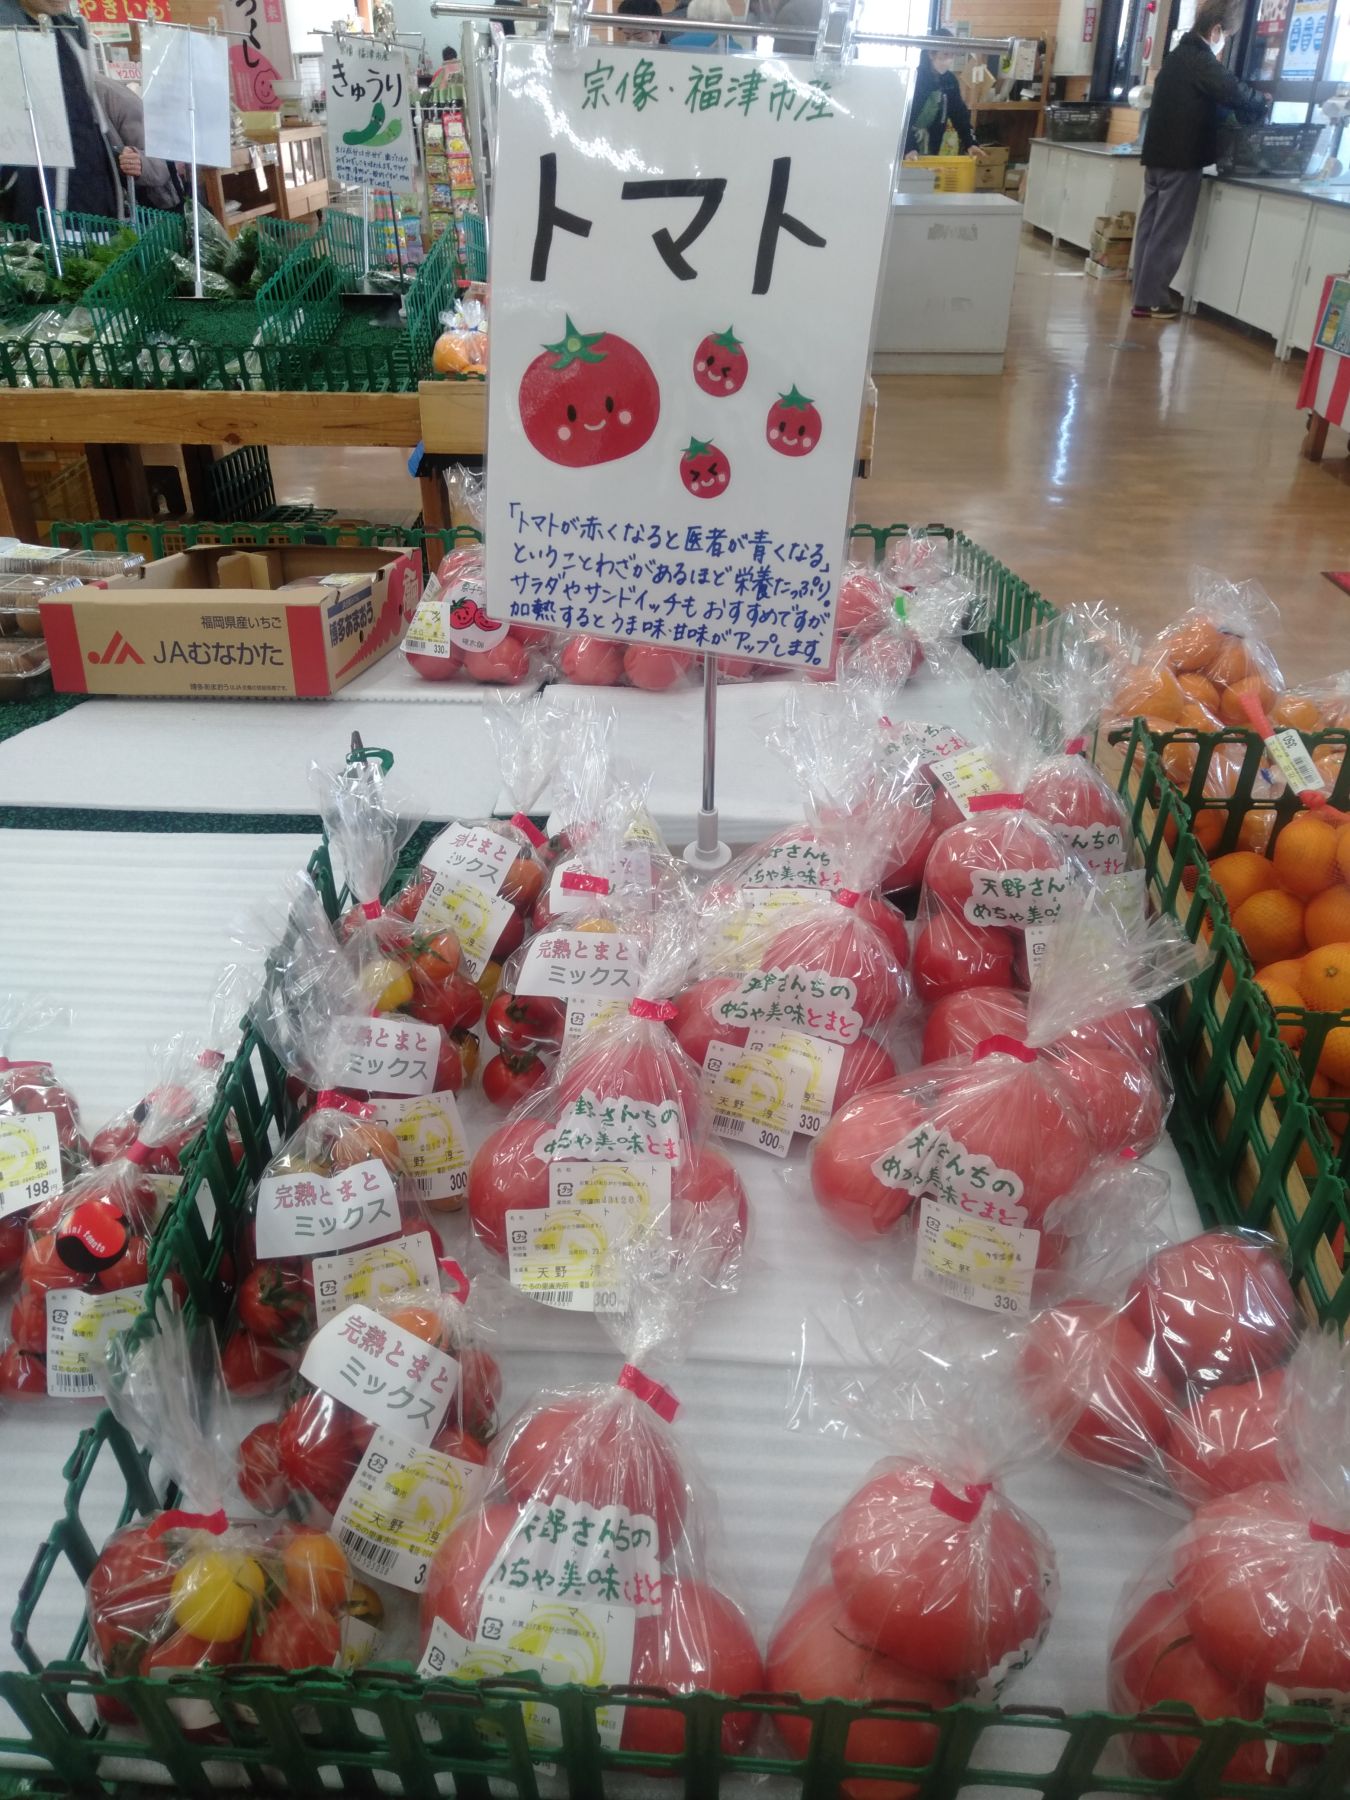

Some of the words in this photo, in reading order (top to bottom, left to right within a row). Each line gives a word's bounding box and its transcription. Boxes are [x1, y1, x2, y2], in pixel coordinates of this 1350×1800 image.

[332, 59, 402, 107] きゅうり
[582, 58, 834, 121] 宗像・福津市産
[530, 152, 828, 295] トマト
[509, 502, 830, 573] 「トマトが赤くなると医者が青くなる」
[510, 571, 831, 637] サラダやサンドイッチもおすすめですが、
[201, 615, 282, 629] 福岡県産いちご
[329, 602, 374, 648] 博多あまおう
[153, 641, 284, 666] JAむなかた
[537, 940, 630, 962] 完熟とまと
[548, 965, 631, 988] ミックス
[348, 1053, 429, 1080] ミックス
[718, 1095, 745, 1111] 天野
[799, 1112, 821, 1132] 330
[273, 1171, 381, 1210] 完熟とまと
[450, 1172, 468, 1191] 300
[294, 1198, 392, 1238] ミックス
[537, 1265, 568, 1279] 天野
[993, 1295, 1018, 1312] 330
[338, 1314, 449, 1394] 完熟とまと
[339, 1356, 436, 1430] ミックス
[369, 1511, 405, 1533] 天野
[530, 1599, 615, 1624] トマト
